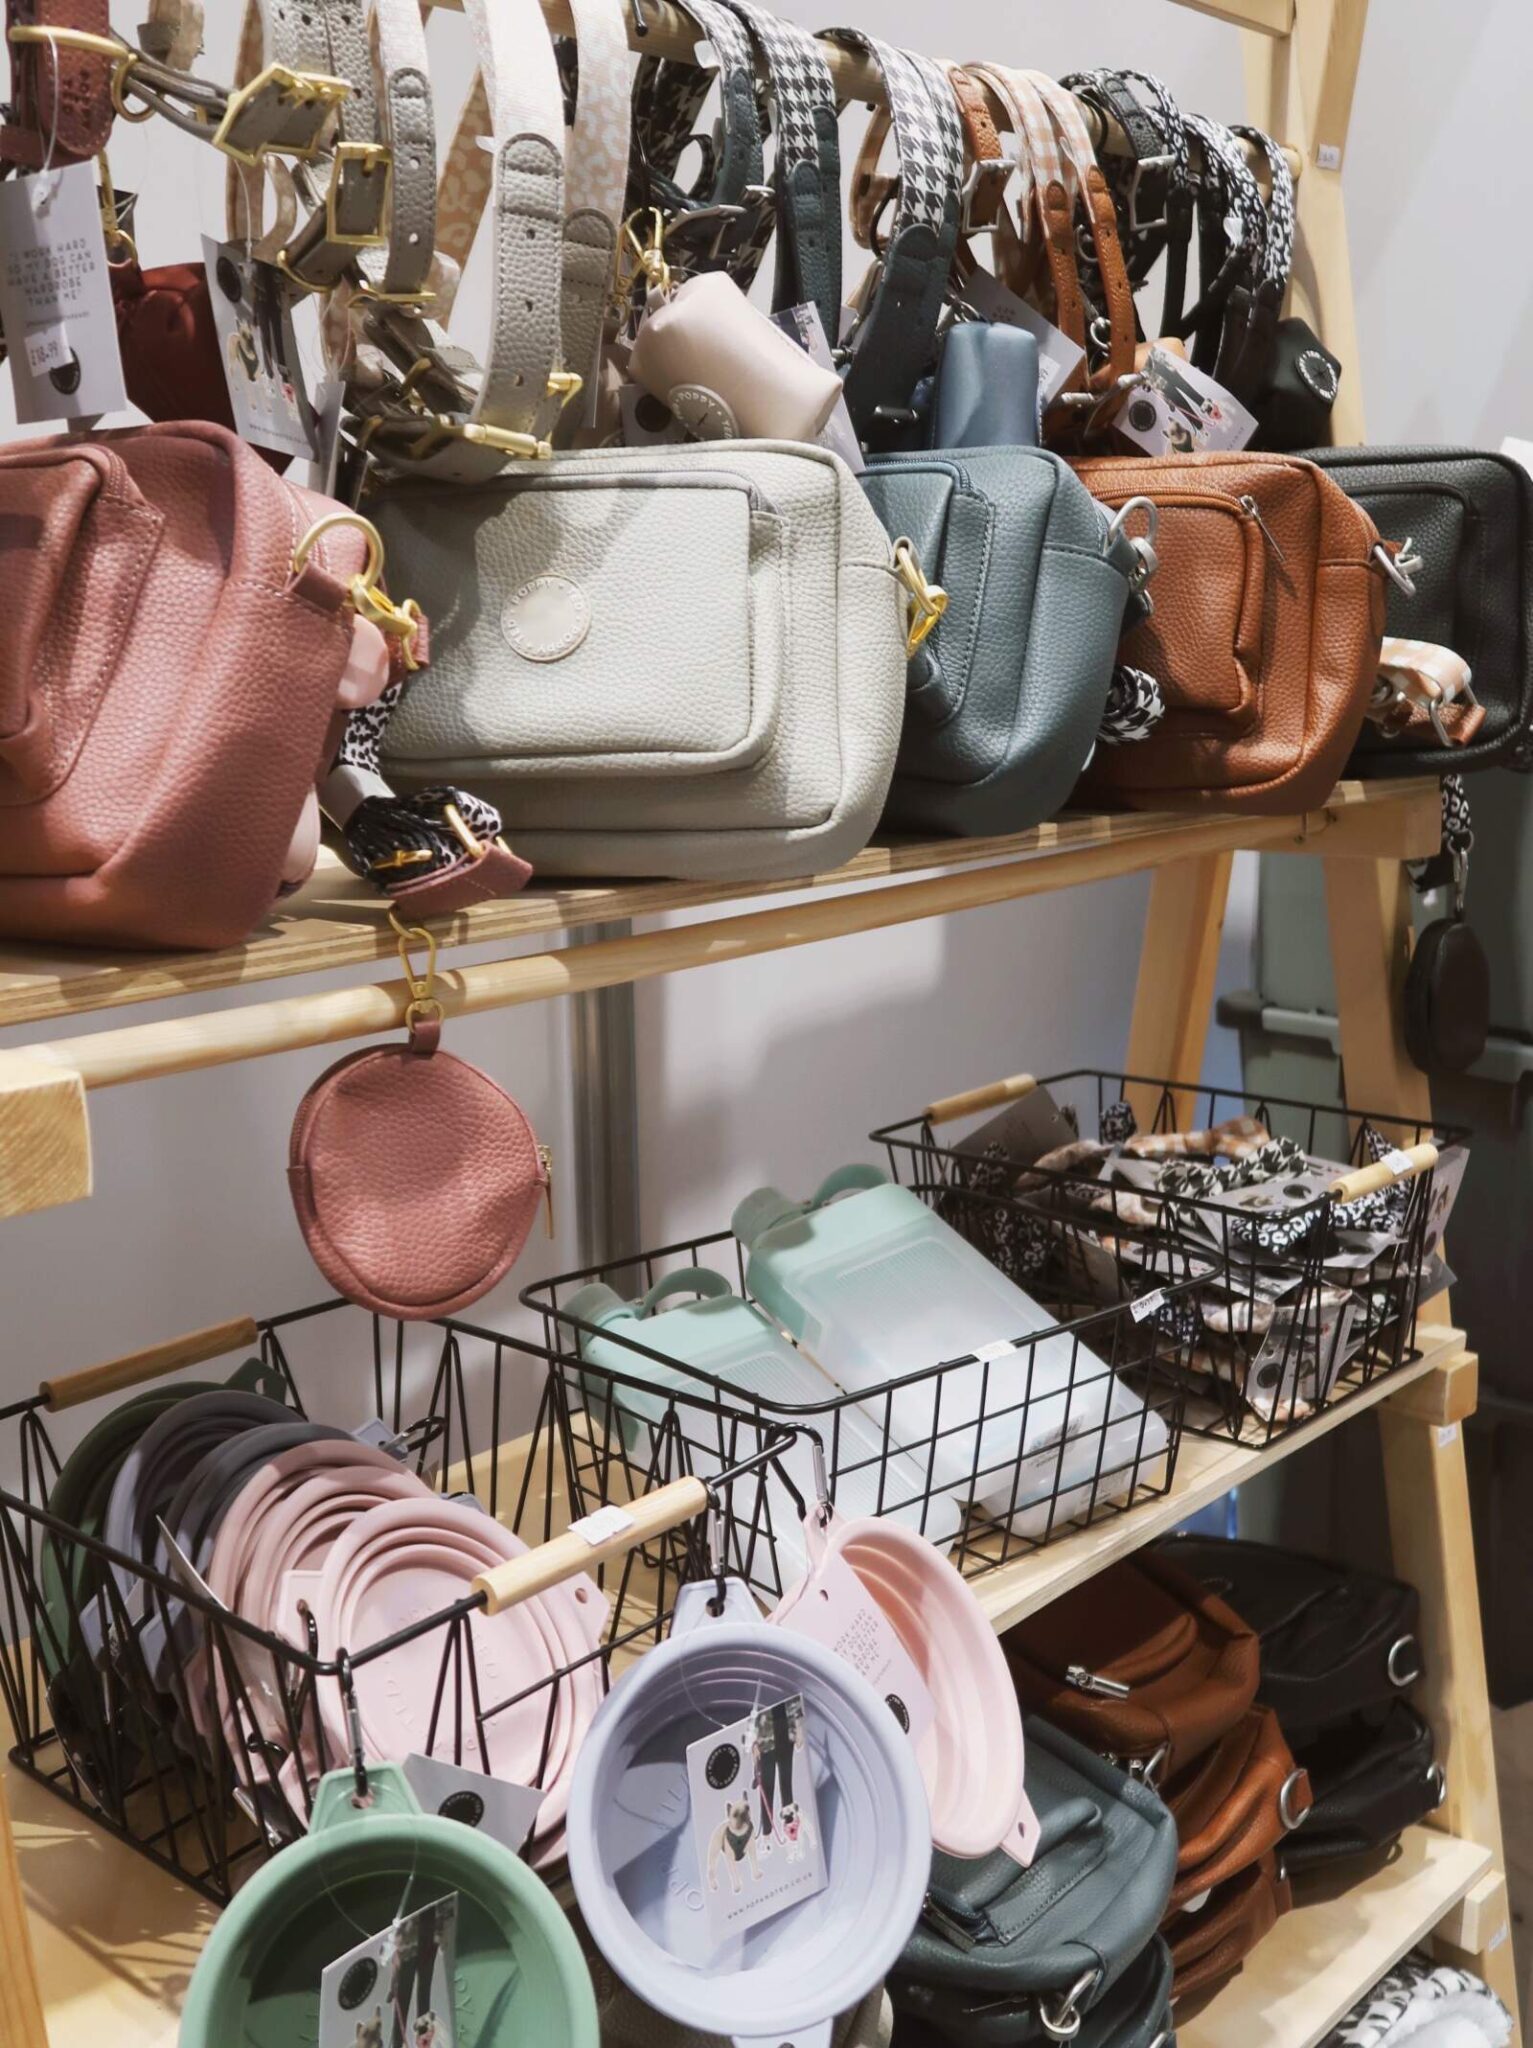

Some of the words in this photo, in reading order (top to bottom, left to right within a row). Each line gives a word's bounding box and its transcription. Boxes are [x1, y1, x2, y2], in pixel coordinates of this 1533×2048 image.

[57, 238, 87, 252] HARD
[70, 250, 92, 263] CAN
[54, 261, 96, 279] BETTER
[24, 276, 82, 294] WARDROBE
[677, 391, 716, 408] POPPY
[511, 577, 552, 605] POPPY
